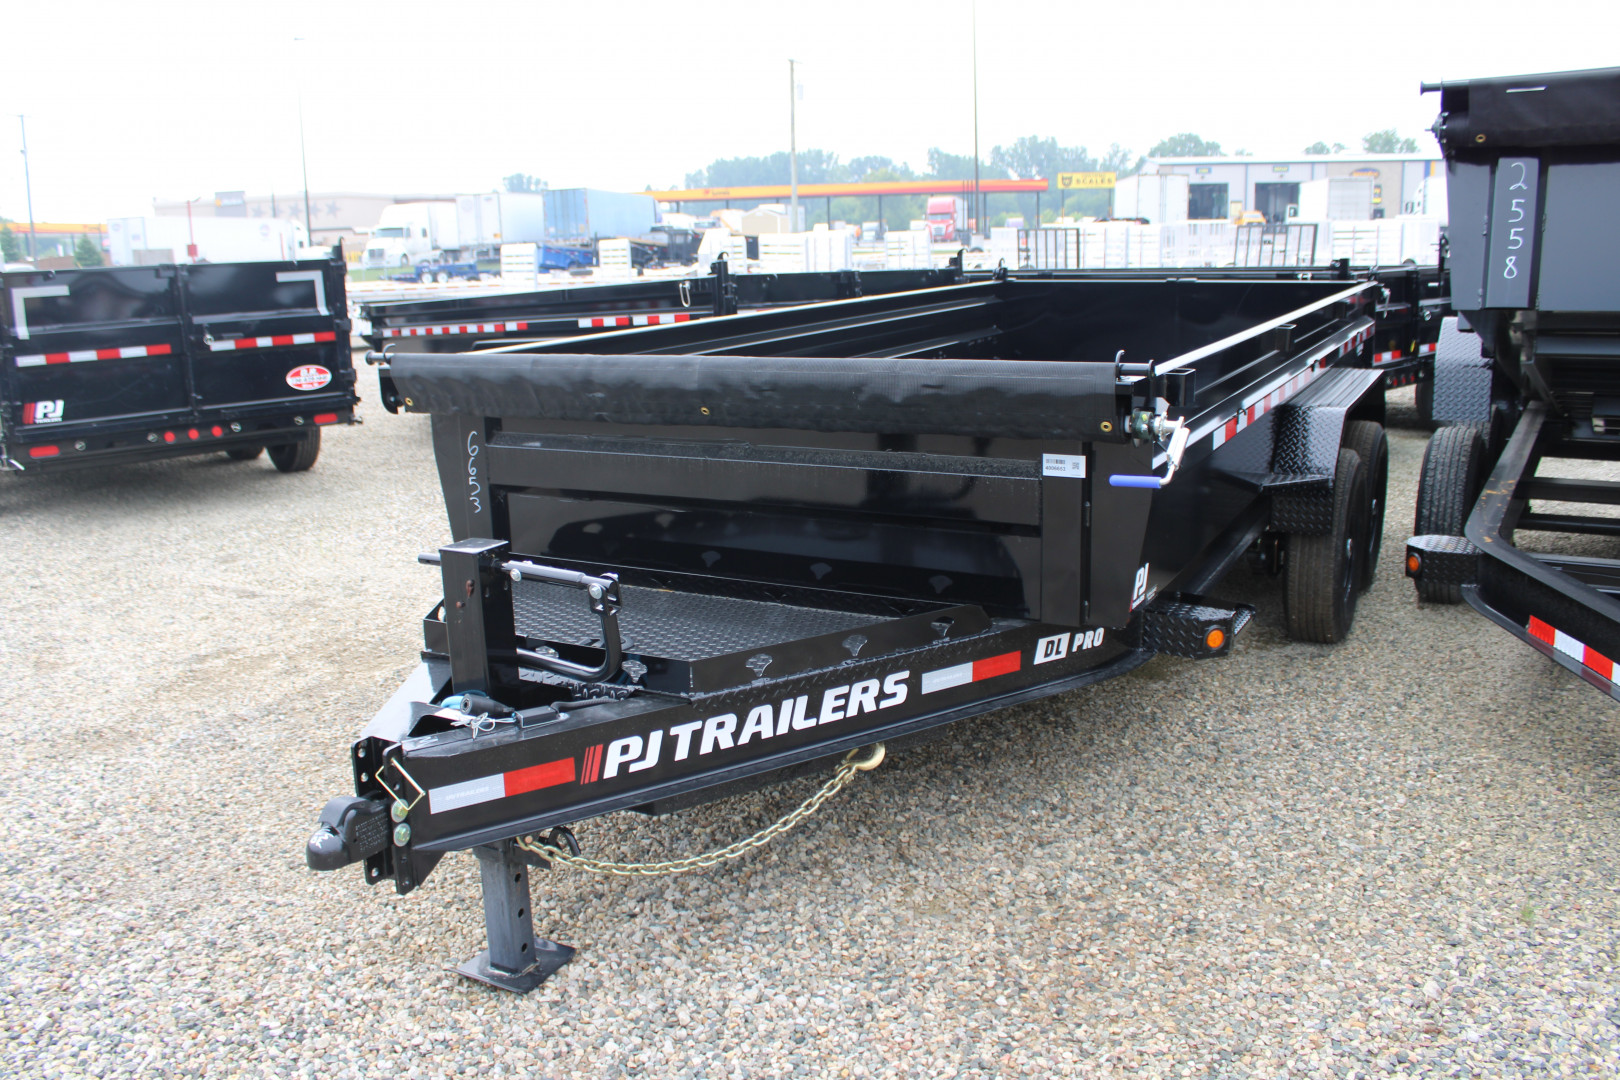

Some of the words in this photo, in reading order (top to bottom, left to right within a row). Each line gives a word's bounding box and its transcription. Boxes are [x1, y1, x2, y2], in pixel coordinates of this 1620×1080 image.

[1503, 161, 1528, 279] 2558
[35, 400, 64, 419] PJ
[467, 430, 481, 514] 6653
[1133, 562, 1150, 601] PJ
[1043, 637, 1063, 659] DL
[1071, 627, 1105, 653] PRO
[602, 729, 664, 780] PJ
[669, 670, 910, 762] TRAILERS
